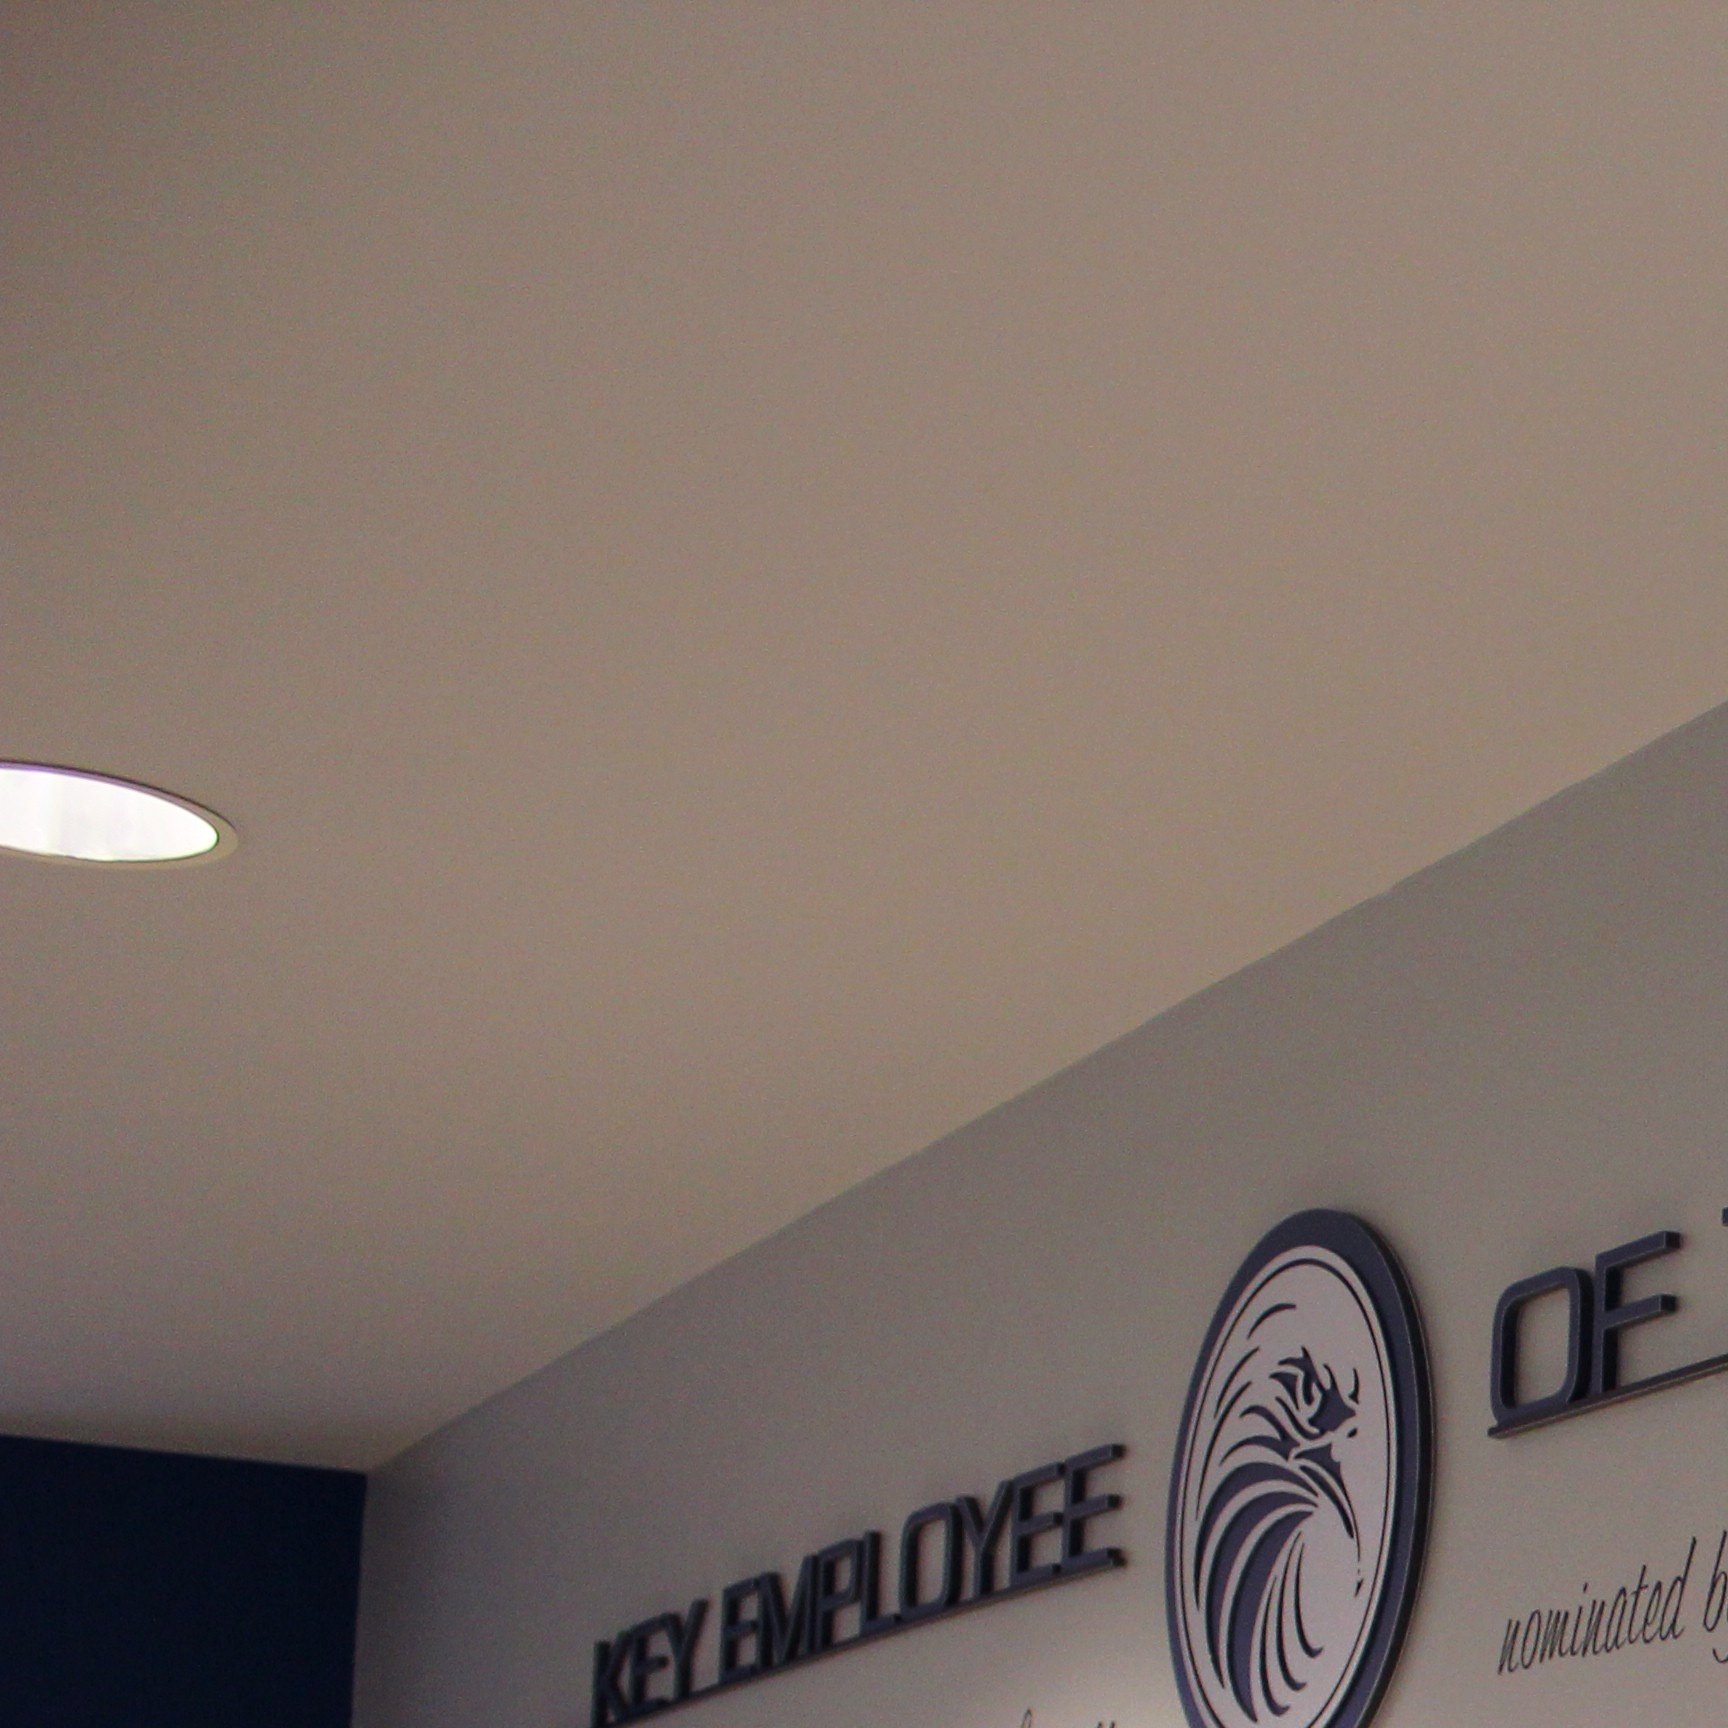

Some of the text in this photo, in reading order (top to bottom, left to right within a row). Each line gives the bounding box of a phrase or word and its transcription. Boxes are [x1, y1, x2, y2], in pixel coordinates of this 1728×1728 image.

[718, 1443, 1128, 1681] EMPLOYEE
[1490, 1229, 1682, 1424] OF
[1498, 1533, 1696, 1676] nominated
